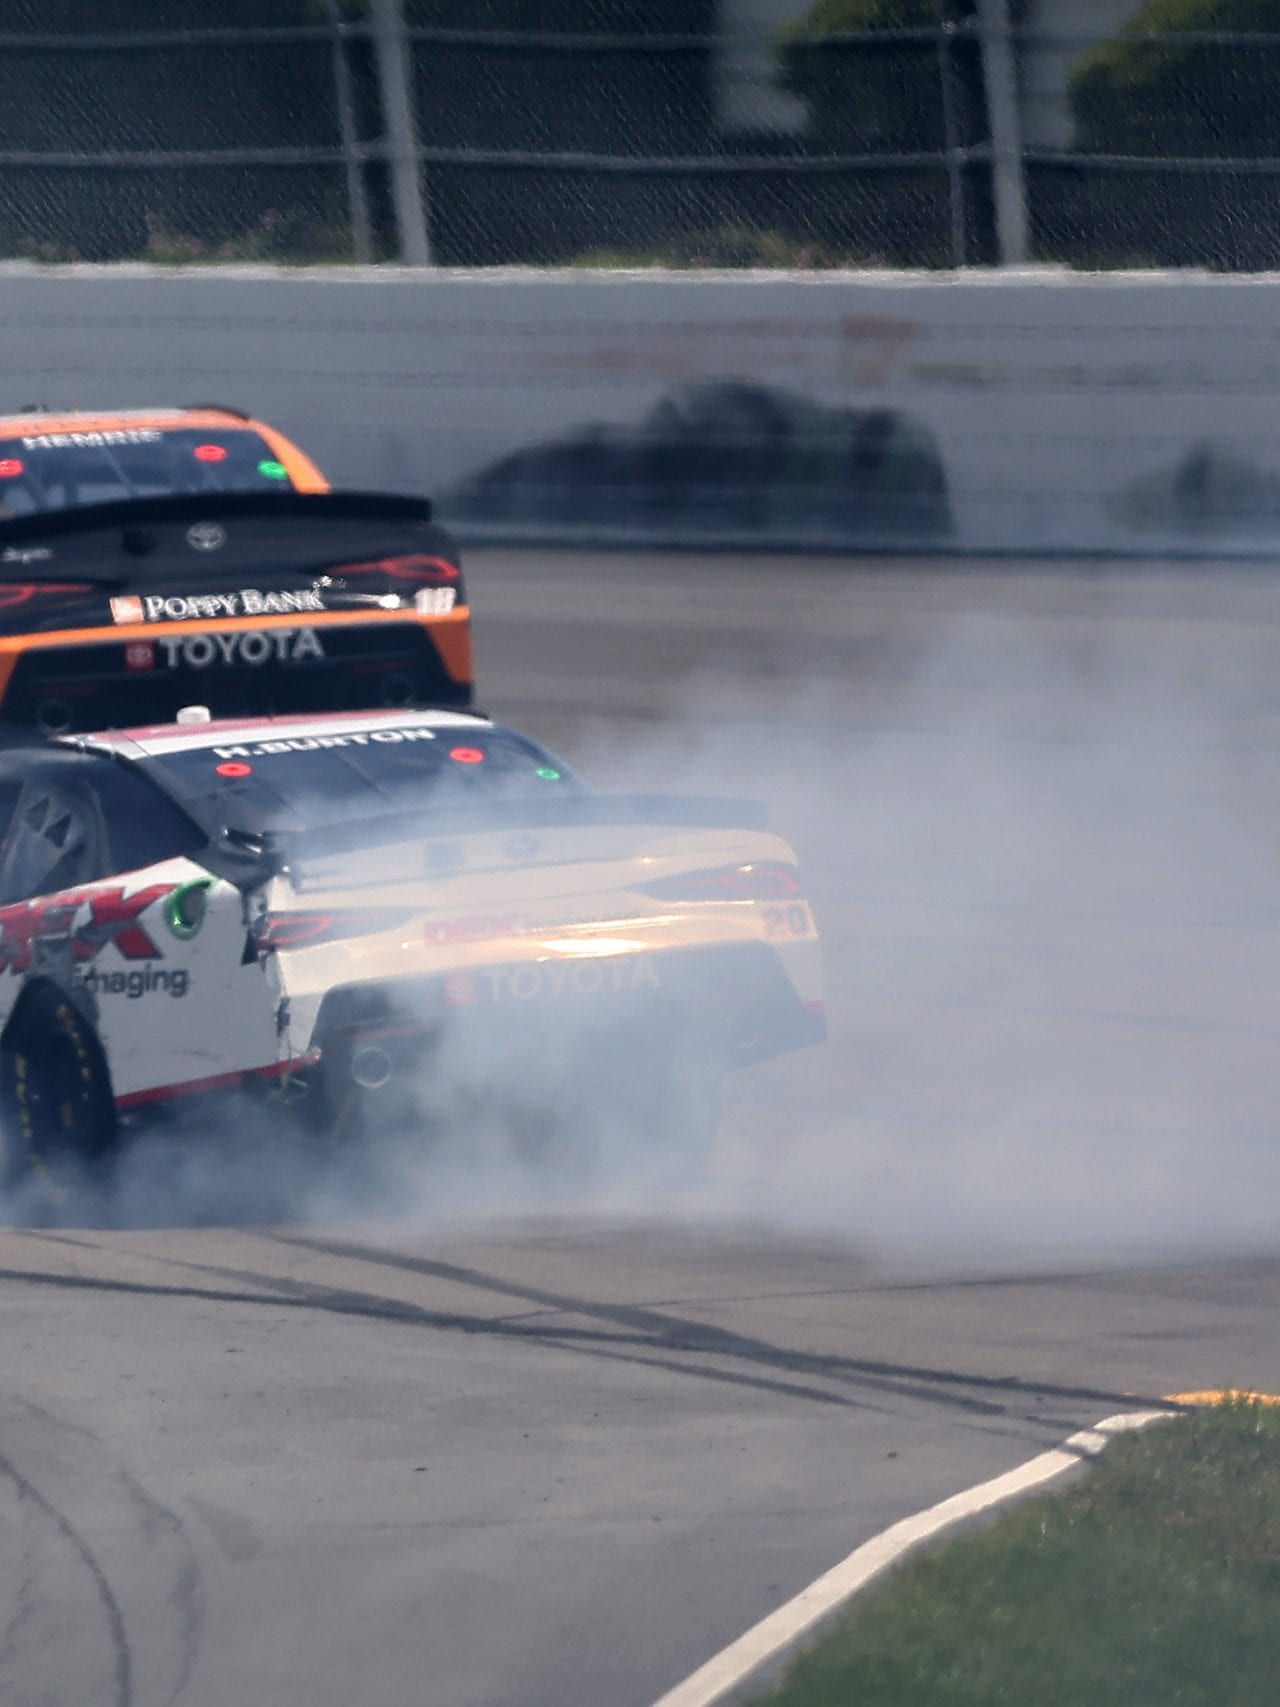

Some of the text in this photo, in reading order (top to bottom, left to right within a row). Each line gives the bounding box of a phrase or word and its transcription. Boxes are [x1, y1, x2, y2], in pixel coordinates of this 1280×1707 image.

[144, 588, 326, 621] POPPY BANK
[160, 627, 325, 668] TOYOTA
[213, 728, 437, 758] H.BURTON
[762, 905, 807, 935] 20
[483, 957, 661, 1002] TOYOTA
